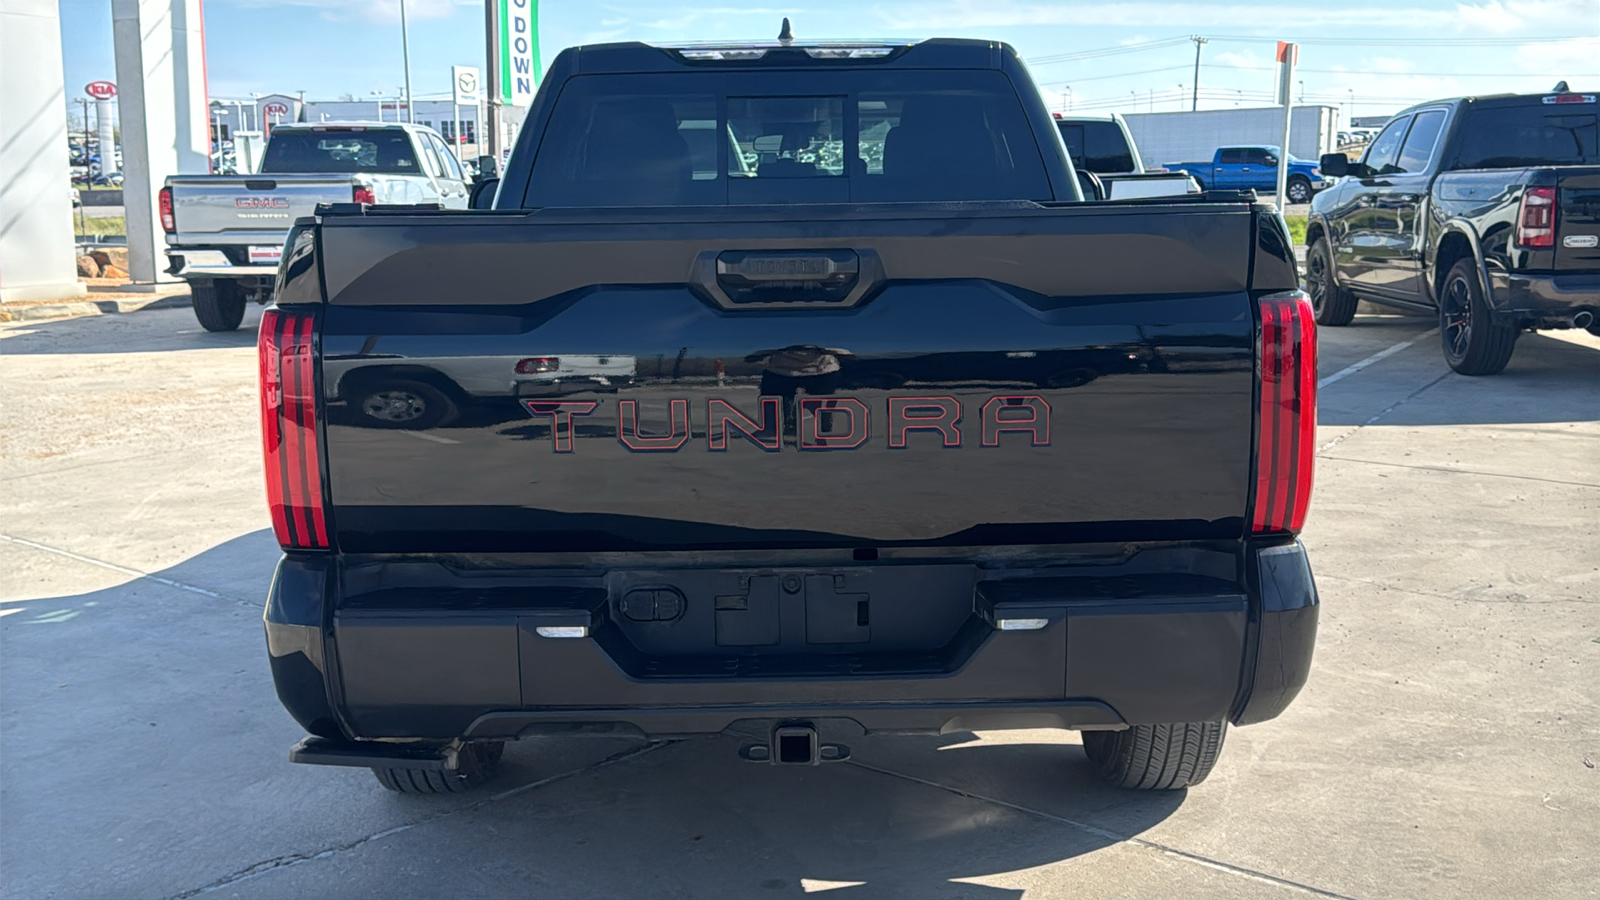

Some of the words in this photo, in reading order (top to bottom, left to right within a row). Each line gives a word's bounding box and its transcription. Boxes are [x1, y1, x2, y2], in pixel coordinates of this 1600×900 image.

[513, 16, 531, 94] DOWN
[92, 84, 115, 95] KIA
[268, 105, 285, 113] KIA
[235, 197, 290, 209] GMC
[519, 395, 1053, 454] TUNDRA
